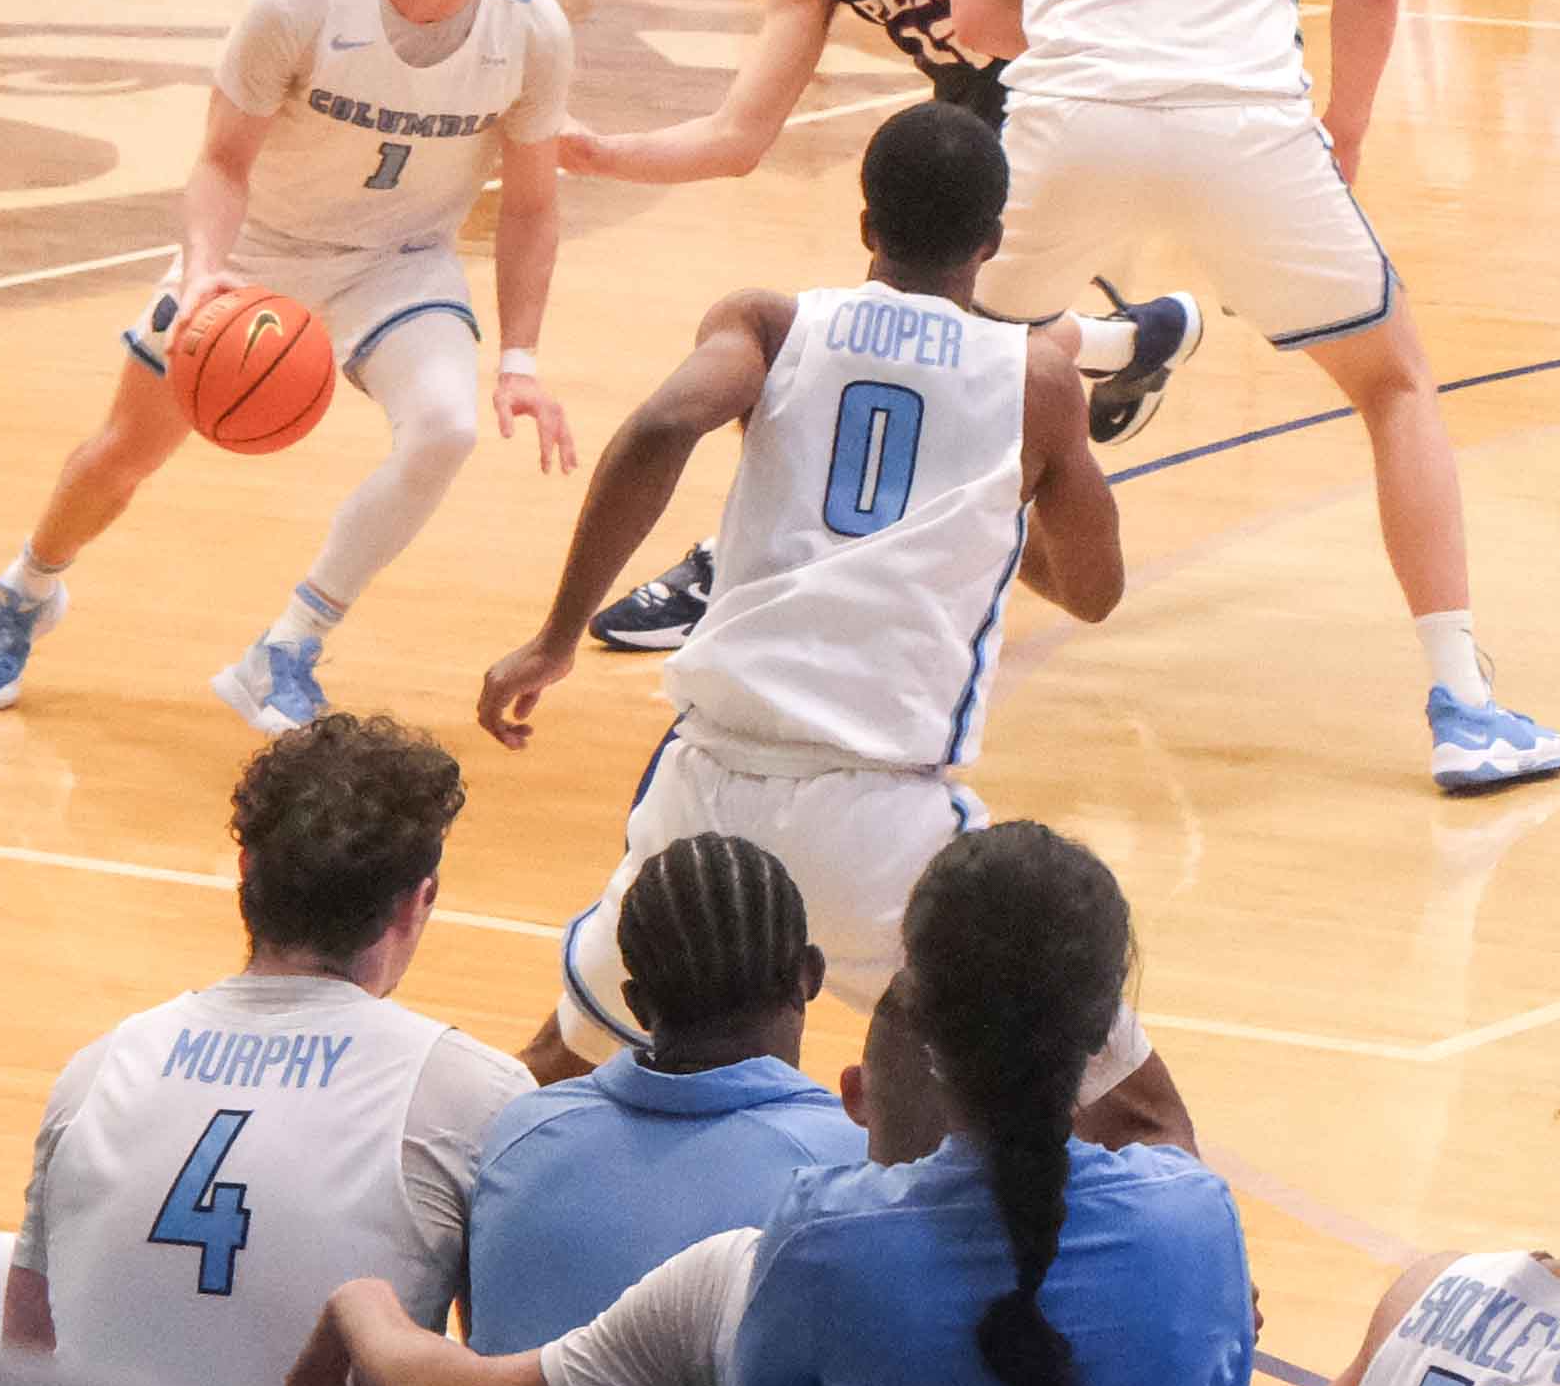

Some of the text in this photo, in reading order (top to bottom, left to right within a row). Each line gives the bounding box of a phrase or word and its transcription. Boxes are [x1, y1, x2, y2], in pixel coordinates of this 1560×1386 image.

[363, 141, 413, 190] 1
[825, 300, 964, 369] COOPER
[822, 379, 925, 539] 0
[161, 1027, 354, 1089] MURPHY
[146, 1108, 254, 1297] 4
